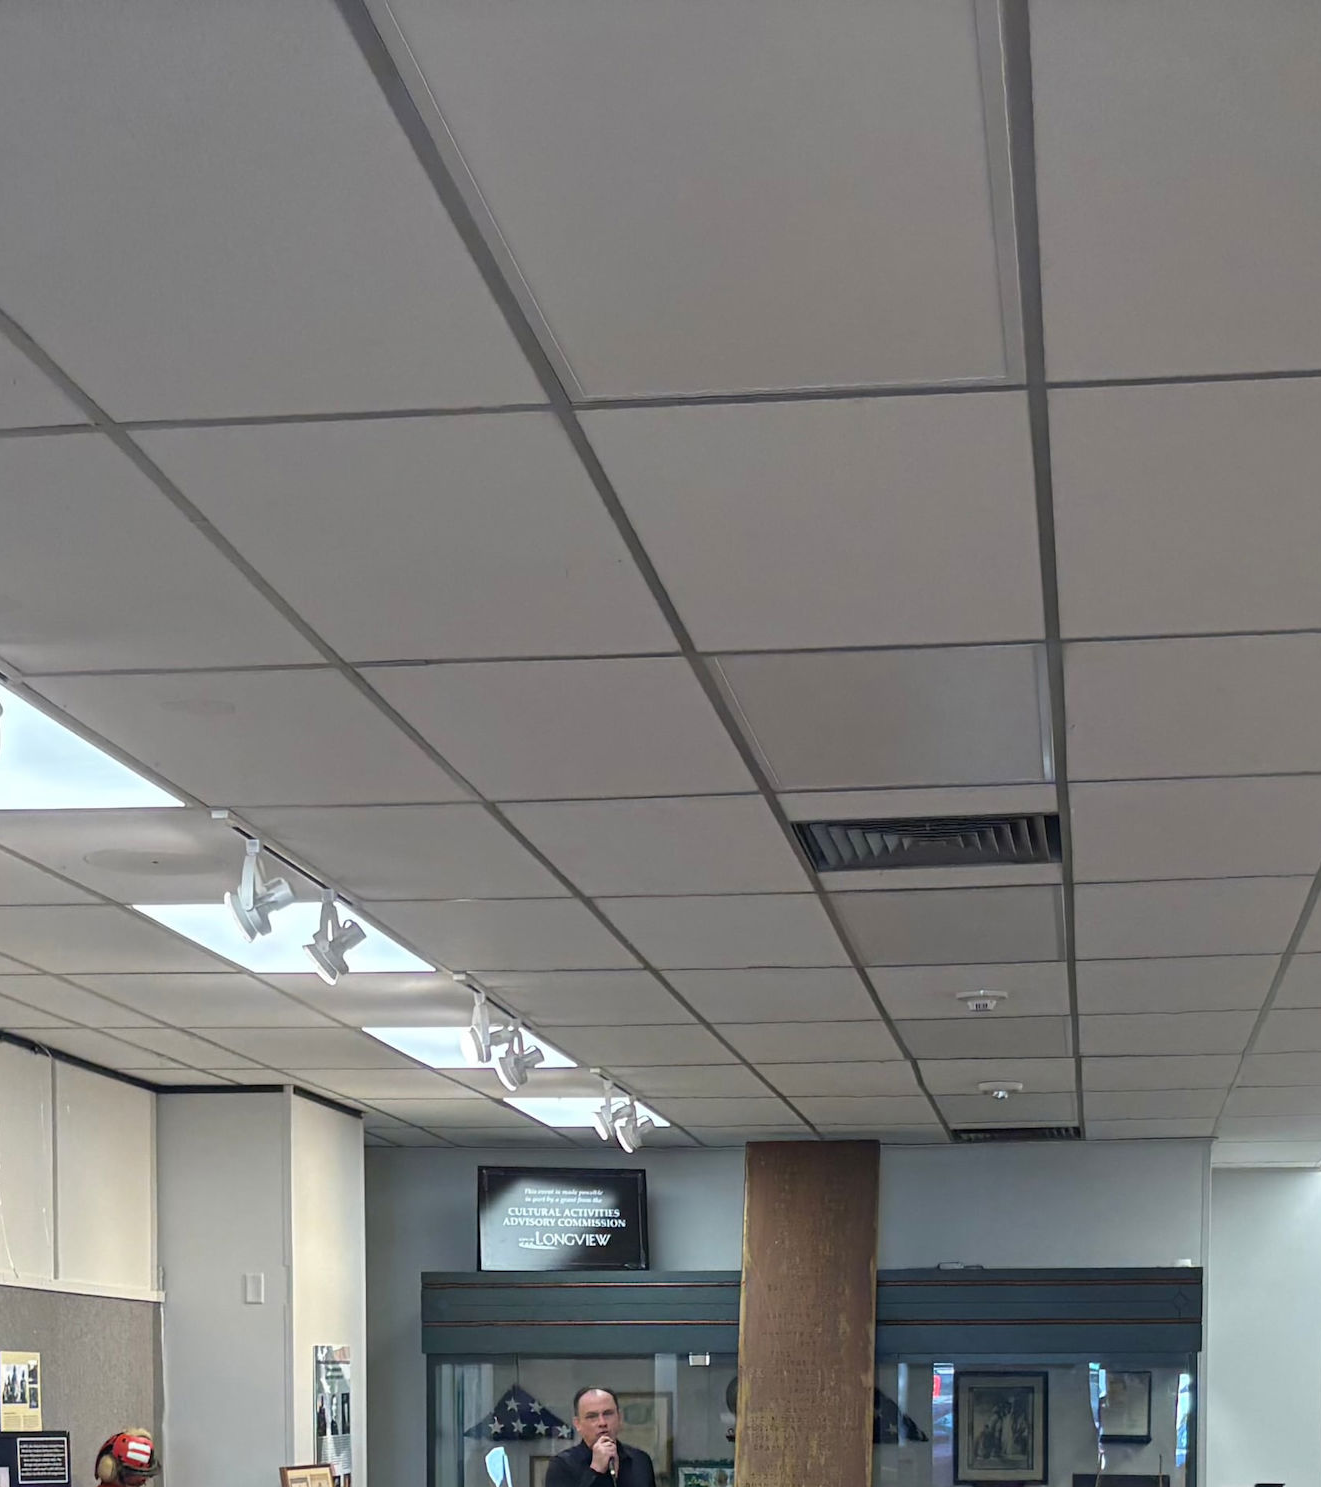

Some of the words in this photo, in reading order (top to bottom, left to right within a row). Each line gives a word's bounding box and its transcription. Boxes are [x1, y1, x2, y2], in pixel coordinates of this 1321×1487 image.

[507, 1207, 561, 1217] CULTURAL
[563, 1208, 620, 1218] ACTIVITIES
[502, 1217, 556, 1227] ADVISORY
[558, 1218, 626, 1228] COMMISSION
[535, 1231, 611, 1247] LONGVIEW
